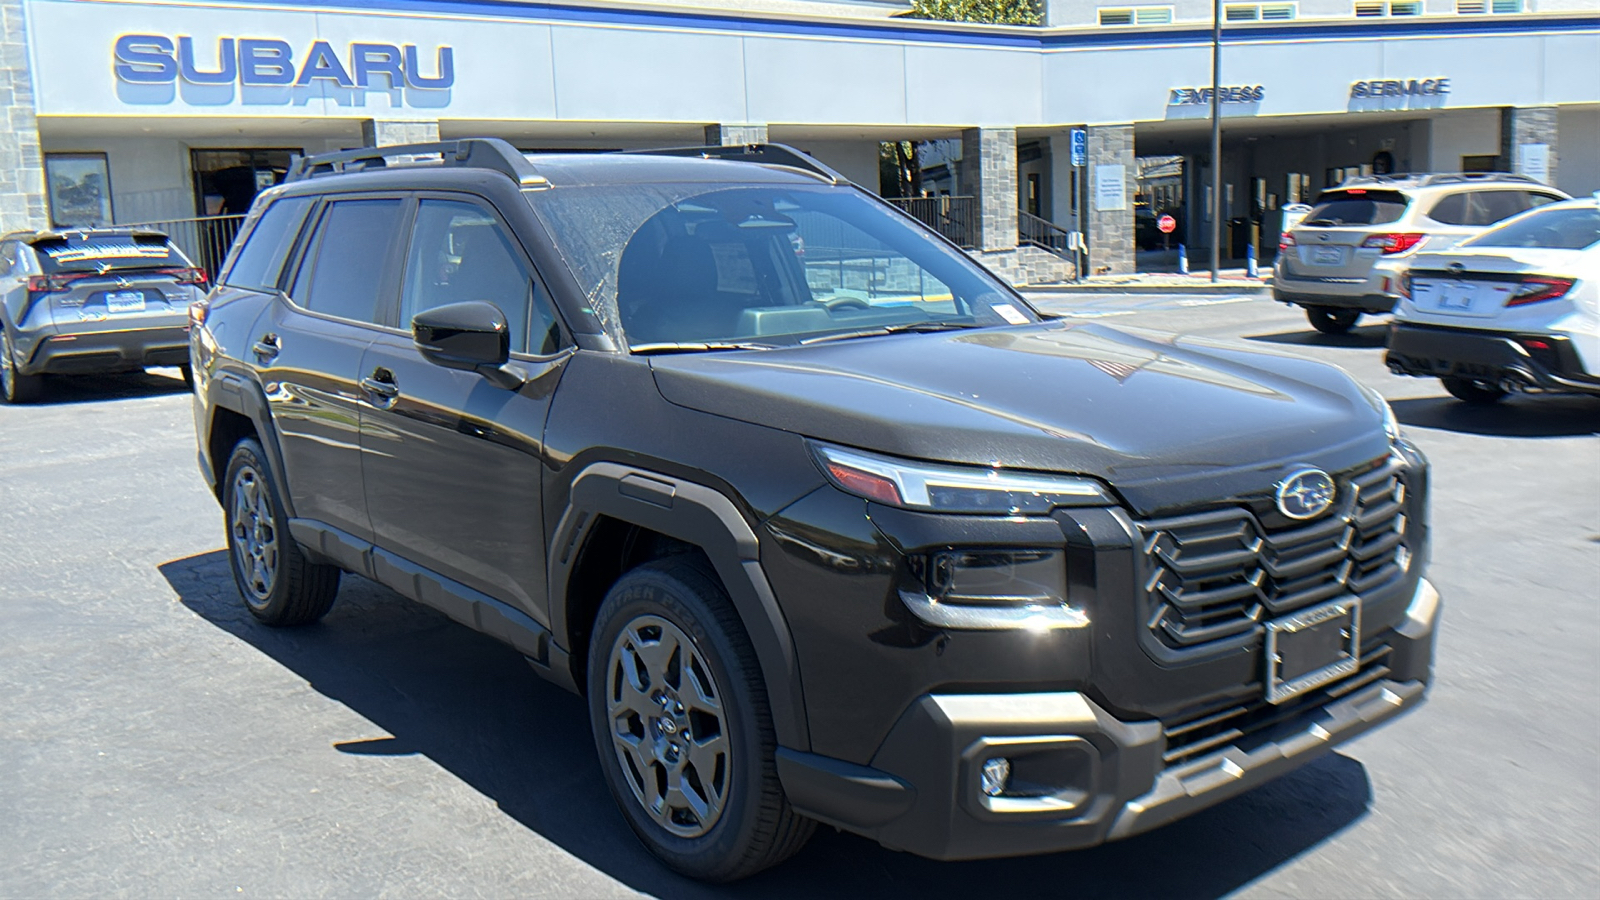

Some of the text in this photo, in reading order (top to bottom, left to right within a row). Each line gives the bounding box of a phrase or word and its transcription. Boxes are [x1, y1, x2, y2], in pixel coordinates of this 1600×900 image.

[115, 34, 454, 89] SUBARU
[1170, 78, 1451, 105] EXPRESS SERVICE
